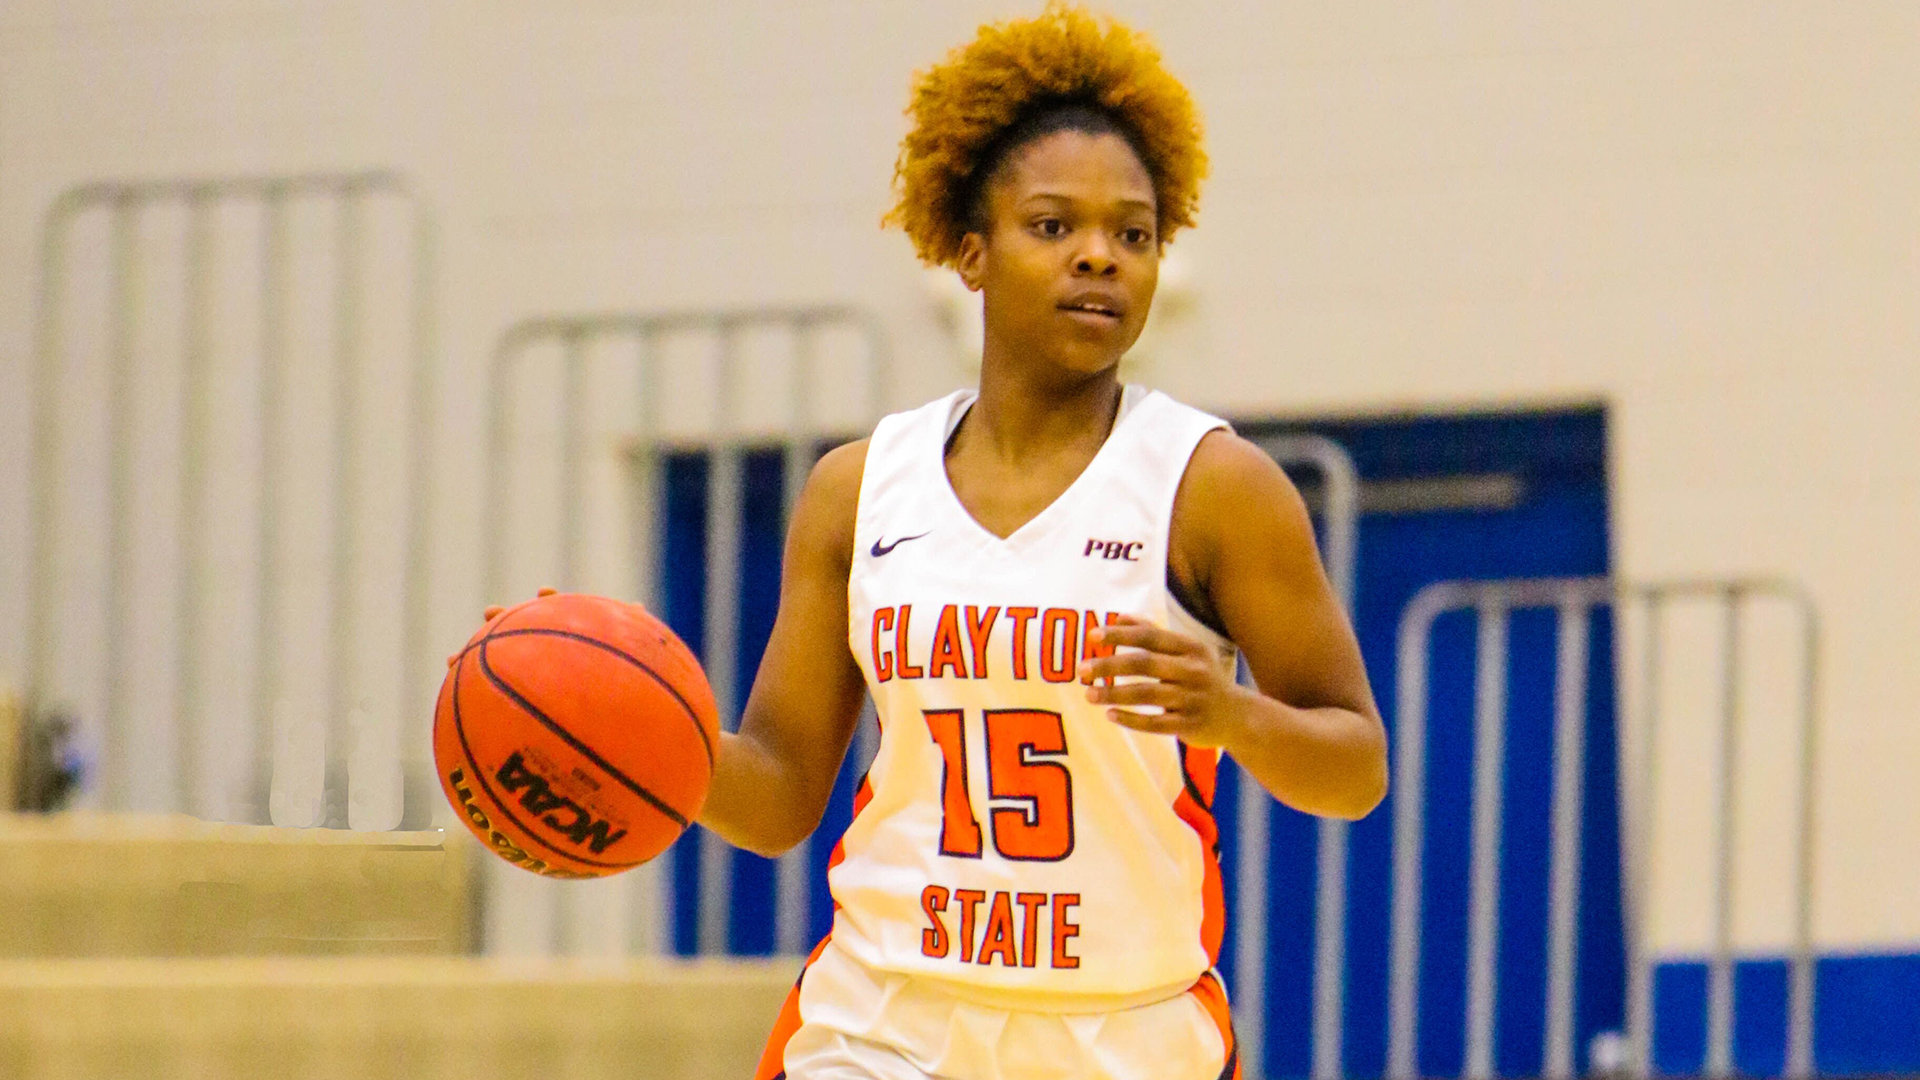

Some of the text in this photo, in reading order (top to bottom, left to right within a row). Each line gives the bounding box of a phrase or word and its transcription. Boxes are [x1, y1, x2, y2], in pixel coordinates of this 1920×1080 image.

[1083, 538, 1144, 562] PBC
[495, 751, 628, 855] NCAA
[921, 708, 1076, 863] 15
[920, 884, 1081, 970] STATE
